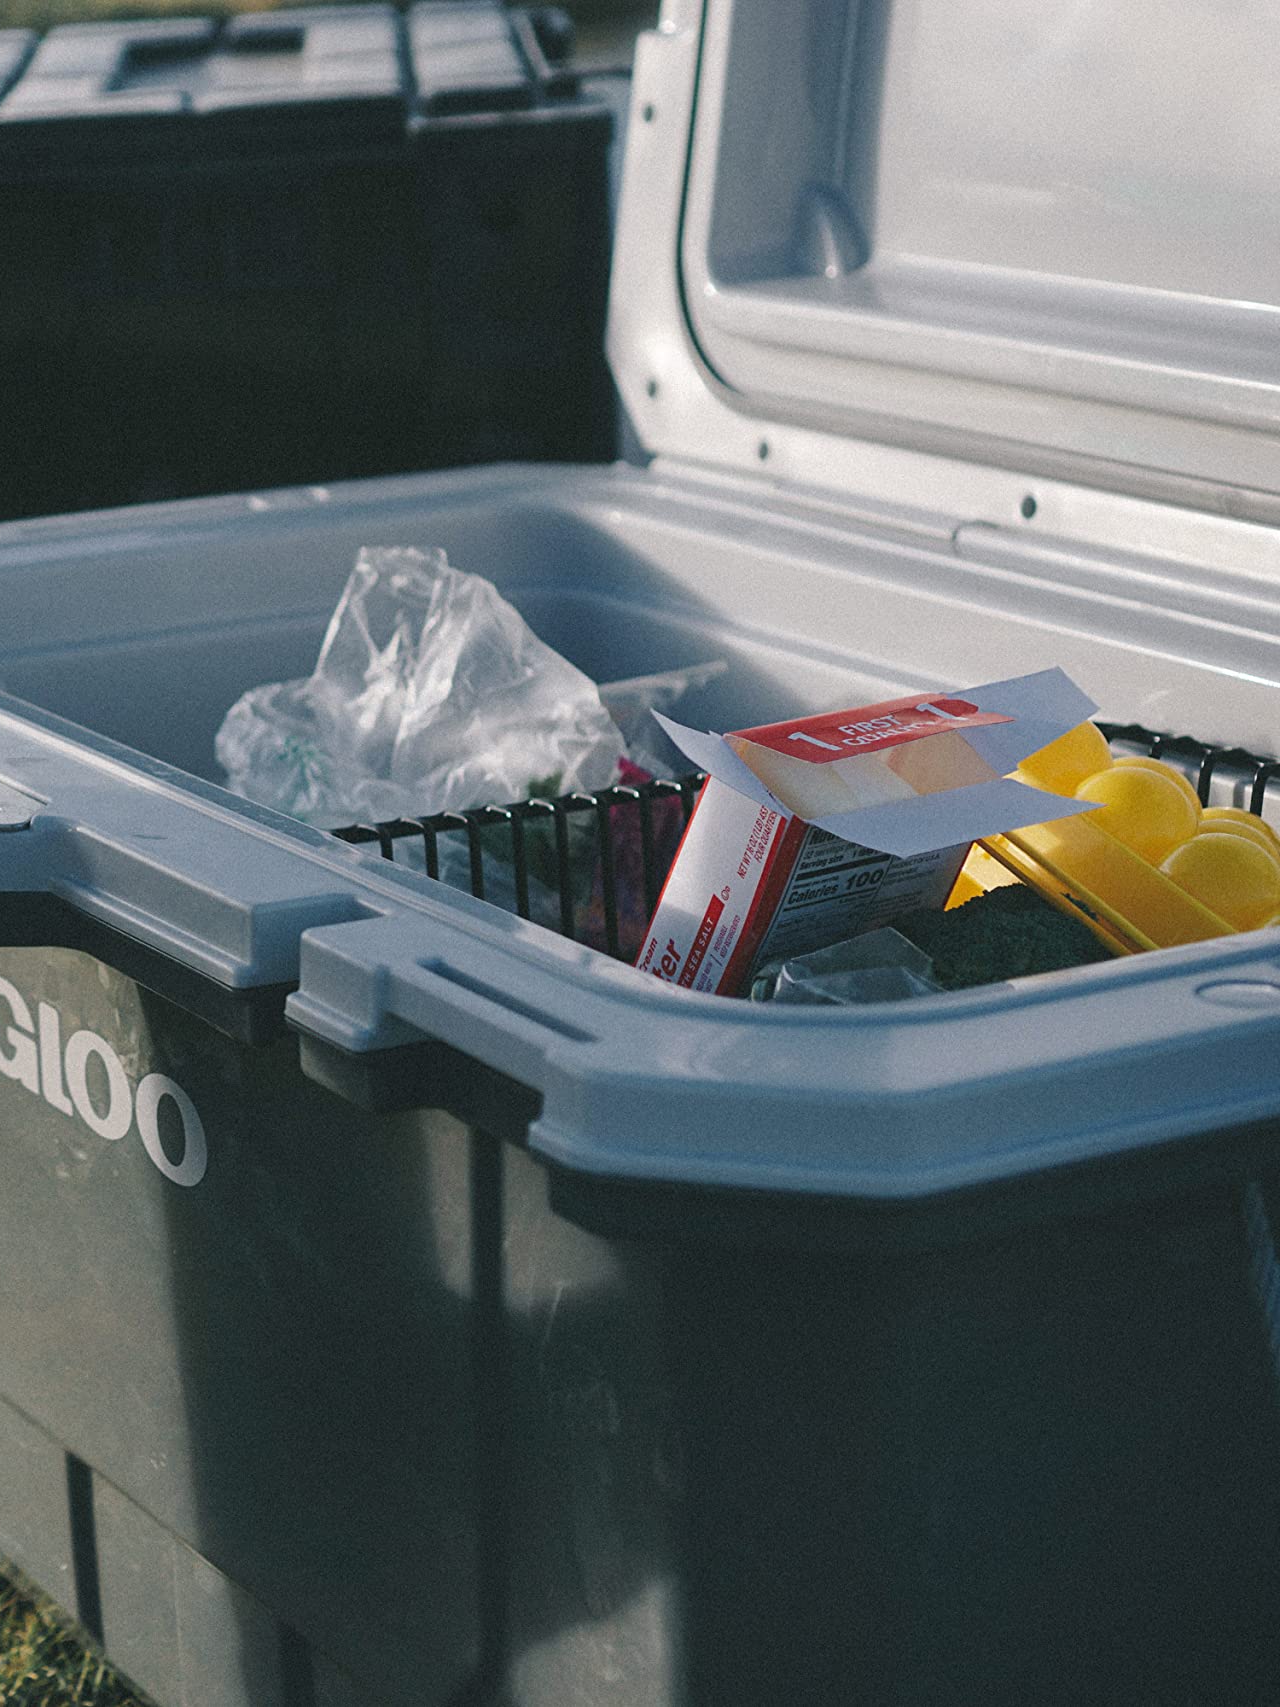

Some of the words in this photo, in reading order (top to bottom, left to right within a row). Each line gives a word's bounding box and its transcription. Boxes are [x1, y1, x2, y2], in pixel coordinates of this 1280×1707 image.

[838, 714, 902, 736] FIRST
[758, 808, 778, 846] QUARTERS
[747, 833, 758, 848] OZ
[741, 850, 752, 866] WT
[752, 841, 766, 863] FOUR
[799, 857, 827, 871] Serving
[827, 854, 844, 865] size
[736, 862, 748, 879] NET
[787, 883, 839, 905] Calories
[845, 869, 884, 890] 100
[687, 947, 701, 971] SEA
[697, 915, 714, 947] SALT
[653, 938, 682, 984] ter
